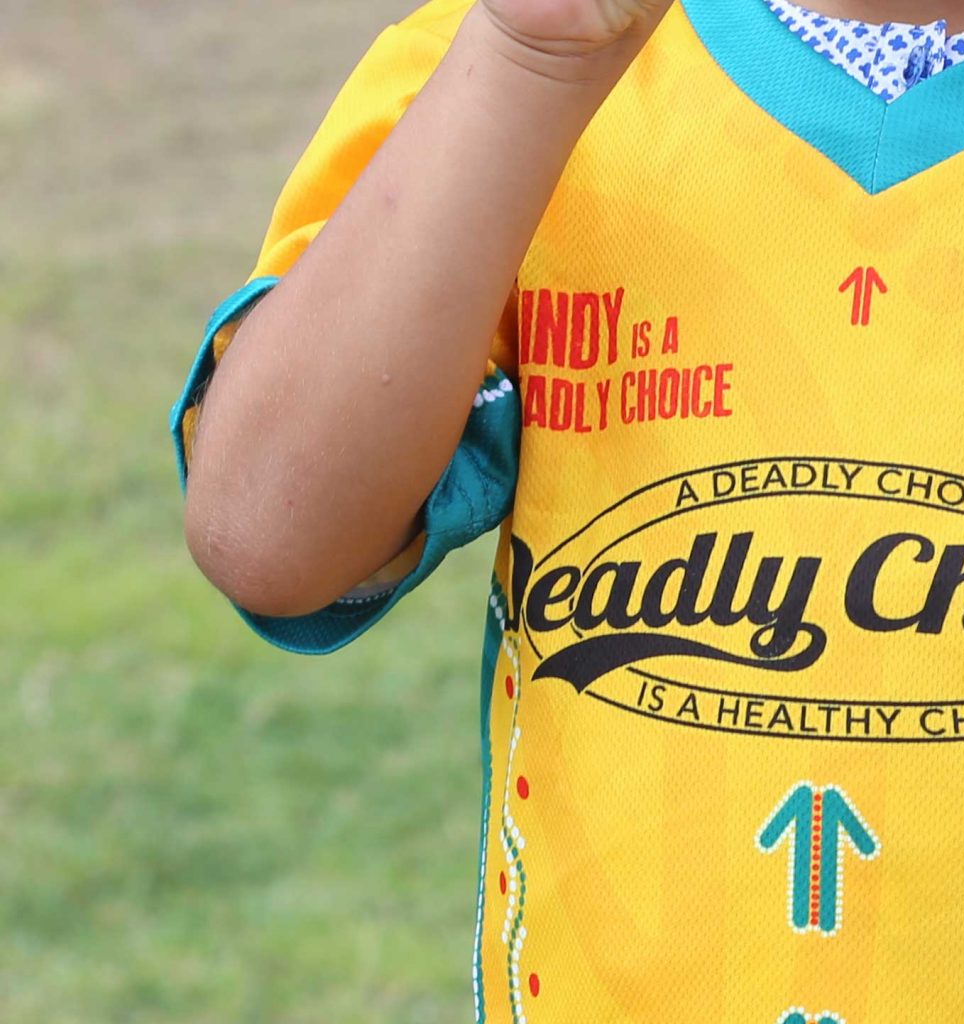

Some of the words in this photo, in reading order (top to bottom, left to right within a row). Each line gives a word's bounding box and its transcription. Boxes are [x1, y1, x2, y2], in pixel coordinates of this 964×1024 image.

[519, 286, 625, 371] INDY
[631, 320, 653, 359] IS
[661, 316, 679, 355] A
[523, 374, 611, 433] ADLY
[620, 363, 734, 425] CHOICE
[675, 480, 700, 508] A
[712, 462, 863, 498] DEADLY
[636, 682, 667, 713] IS
[676, 693, 700, 721] A
[716, 696, 901, 736] HEALTHY
